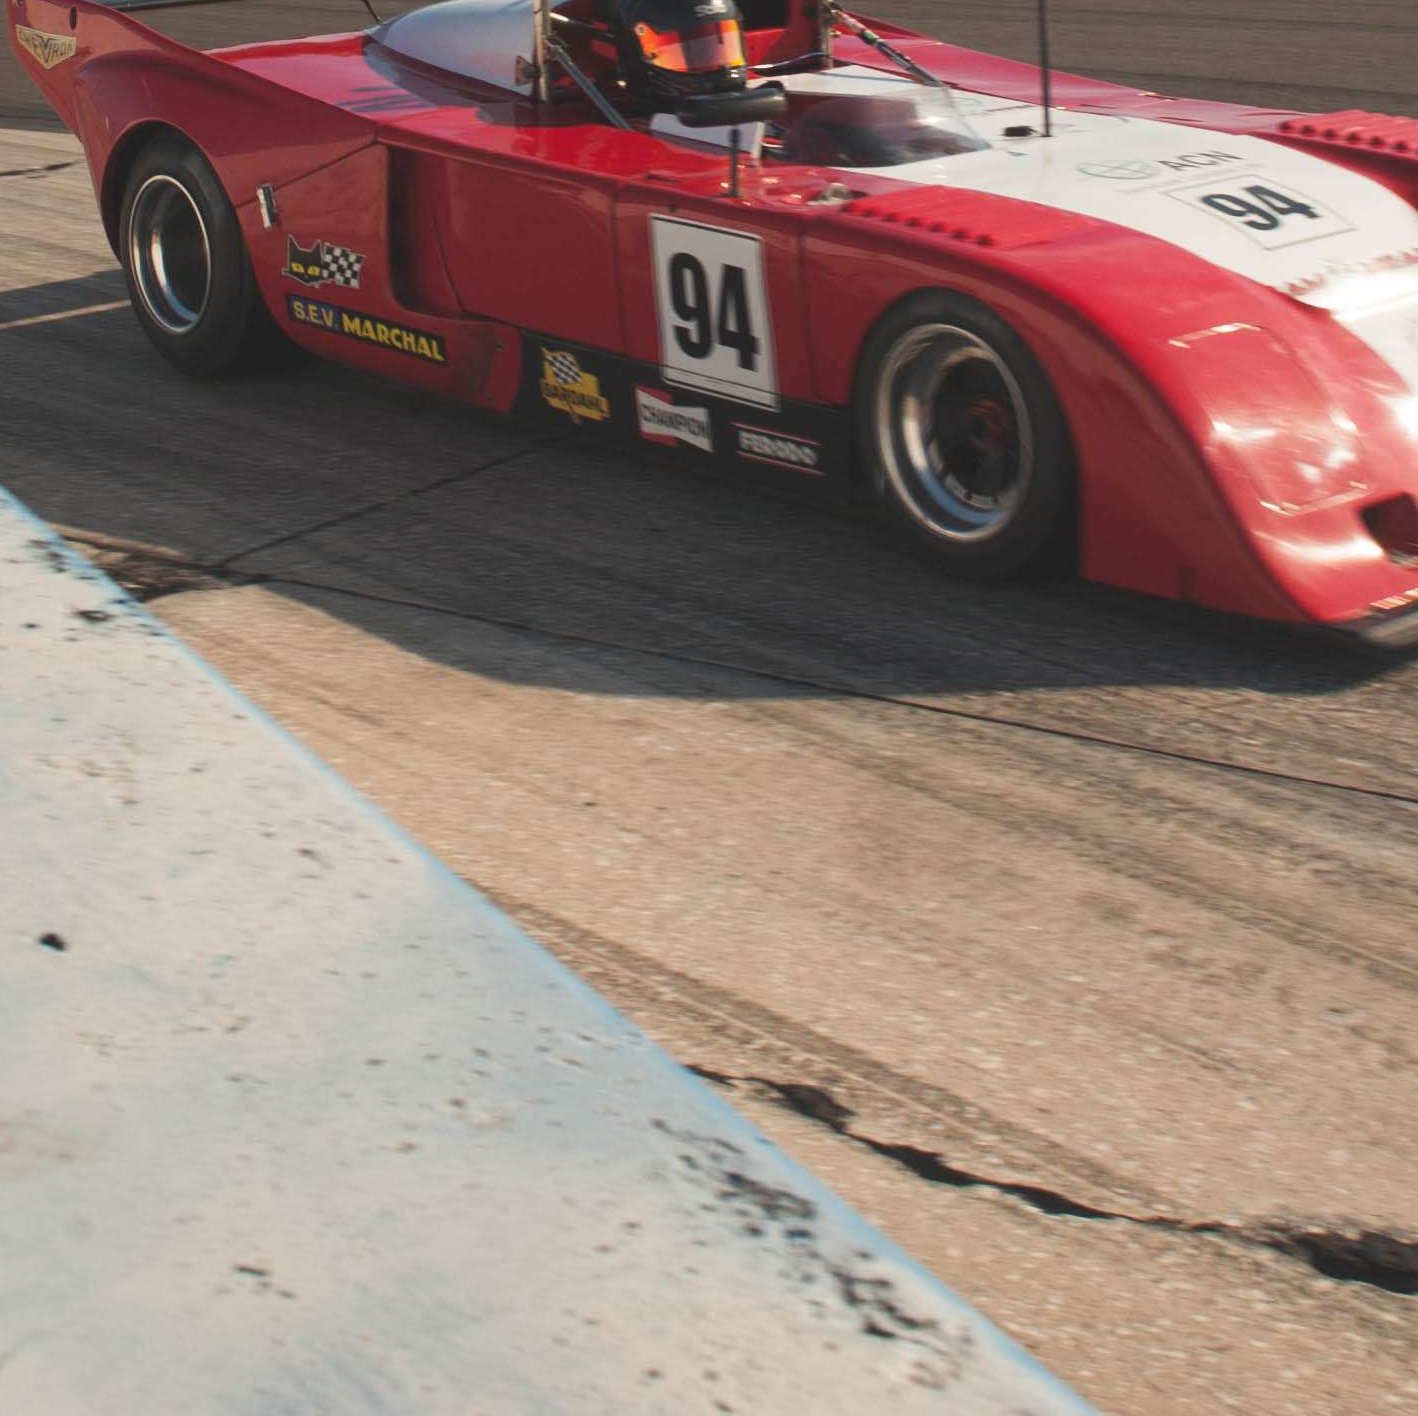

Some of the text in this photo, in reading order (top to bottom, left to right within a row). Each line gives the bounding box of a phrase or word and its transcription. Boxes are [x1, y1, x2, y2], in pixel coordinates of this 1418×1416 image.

[1155, 150, 1245, 172] ACN
[1200, 184, 1321, 232] 94
[668, 251, 761, 372] 94
[341, 312, 446, 362] MARCHAL
[541, 382, 608, 414] BARDAHL
[641, 403, 710, 437] CHAMPION
[737, 430, 818, 467] FERODO
